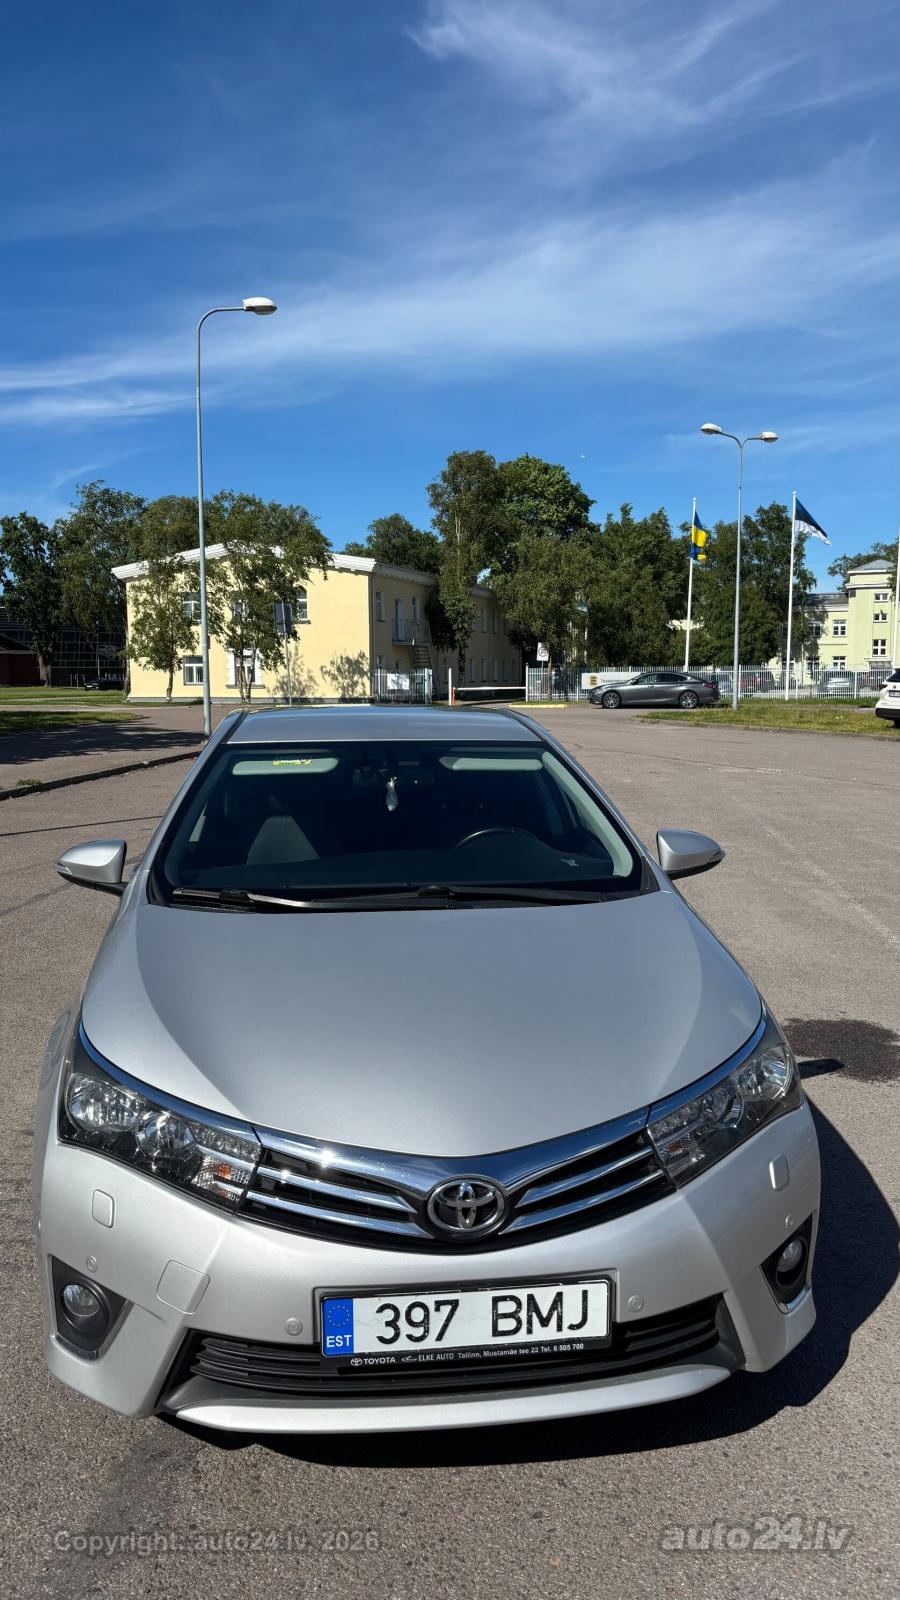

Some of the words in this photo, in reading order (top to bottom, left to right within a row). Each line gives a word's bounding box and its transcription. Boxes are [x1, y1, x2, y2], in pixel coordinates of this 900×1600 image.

[375, 1299, 460, 1345] 397
[491, 1289, 589, 1337] BMJ
[326, 1334, 352, 1348] EST
[363, 1356, 396, 1365] TOYOTA
[418, 1354, 434, 1362] ELKE
[436, 1352, 454, 1361] AUTO
[483, 1349, 518, 1357] Mustamäe
